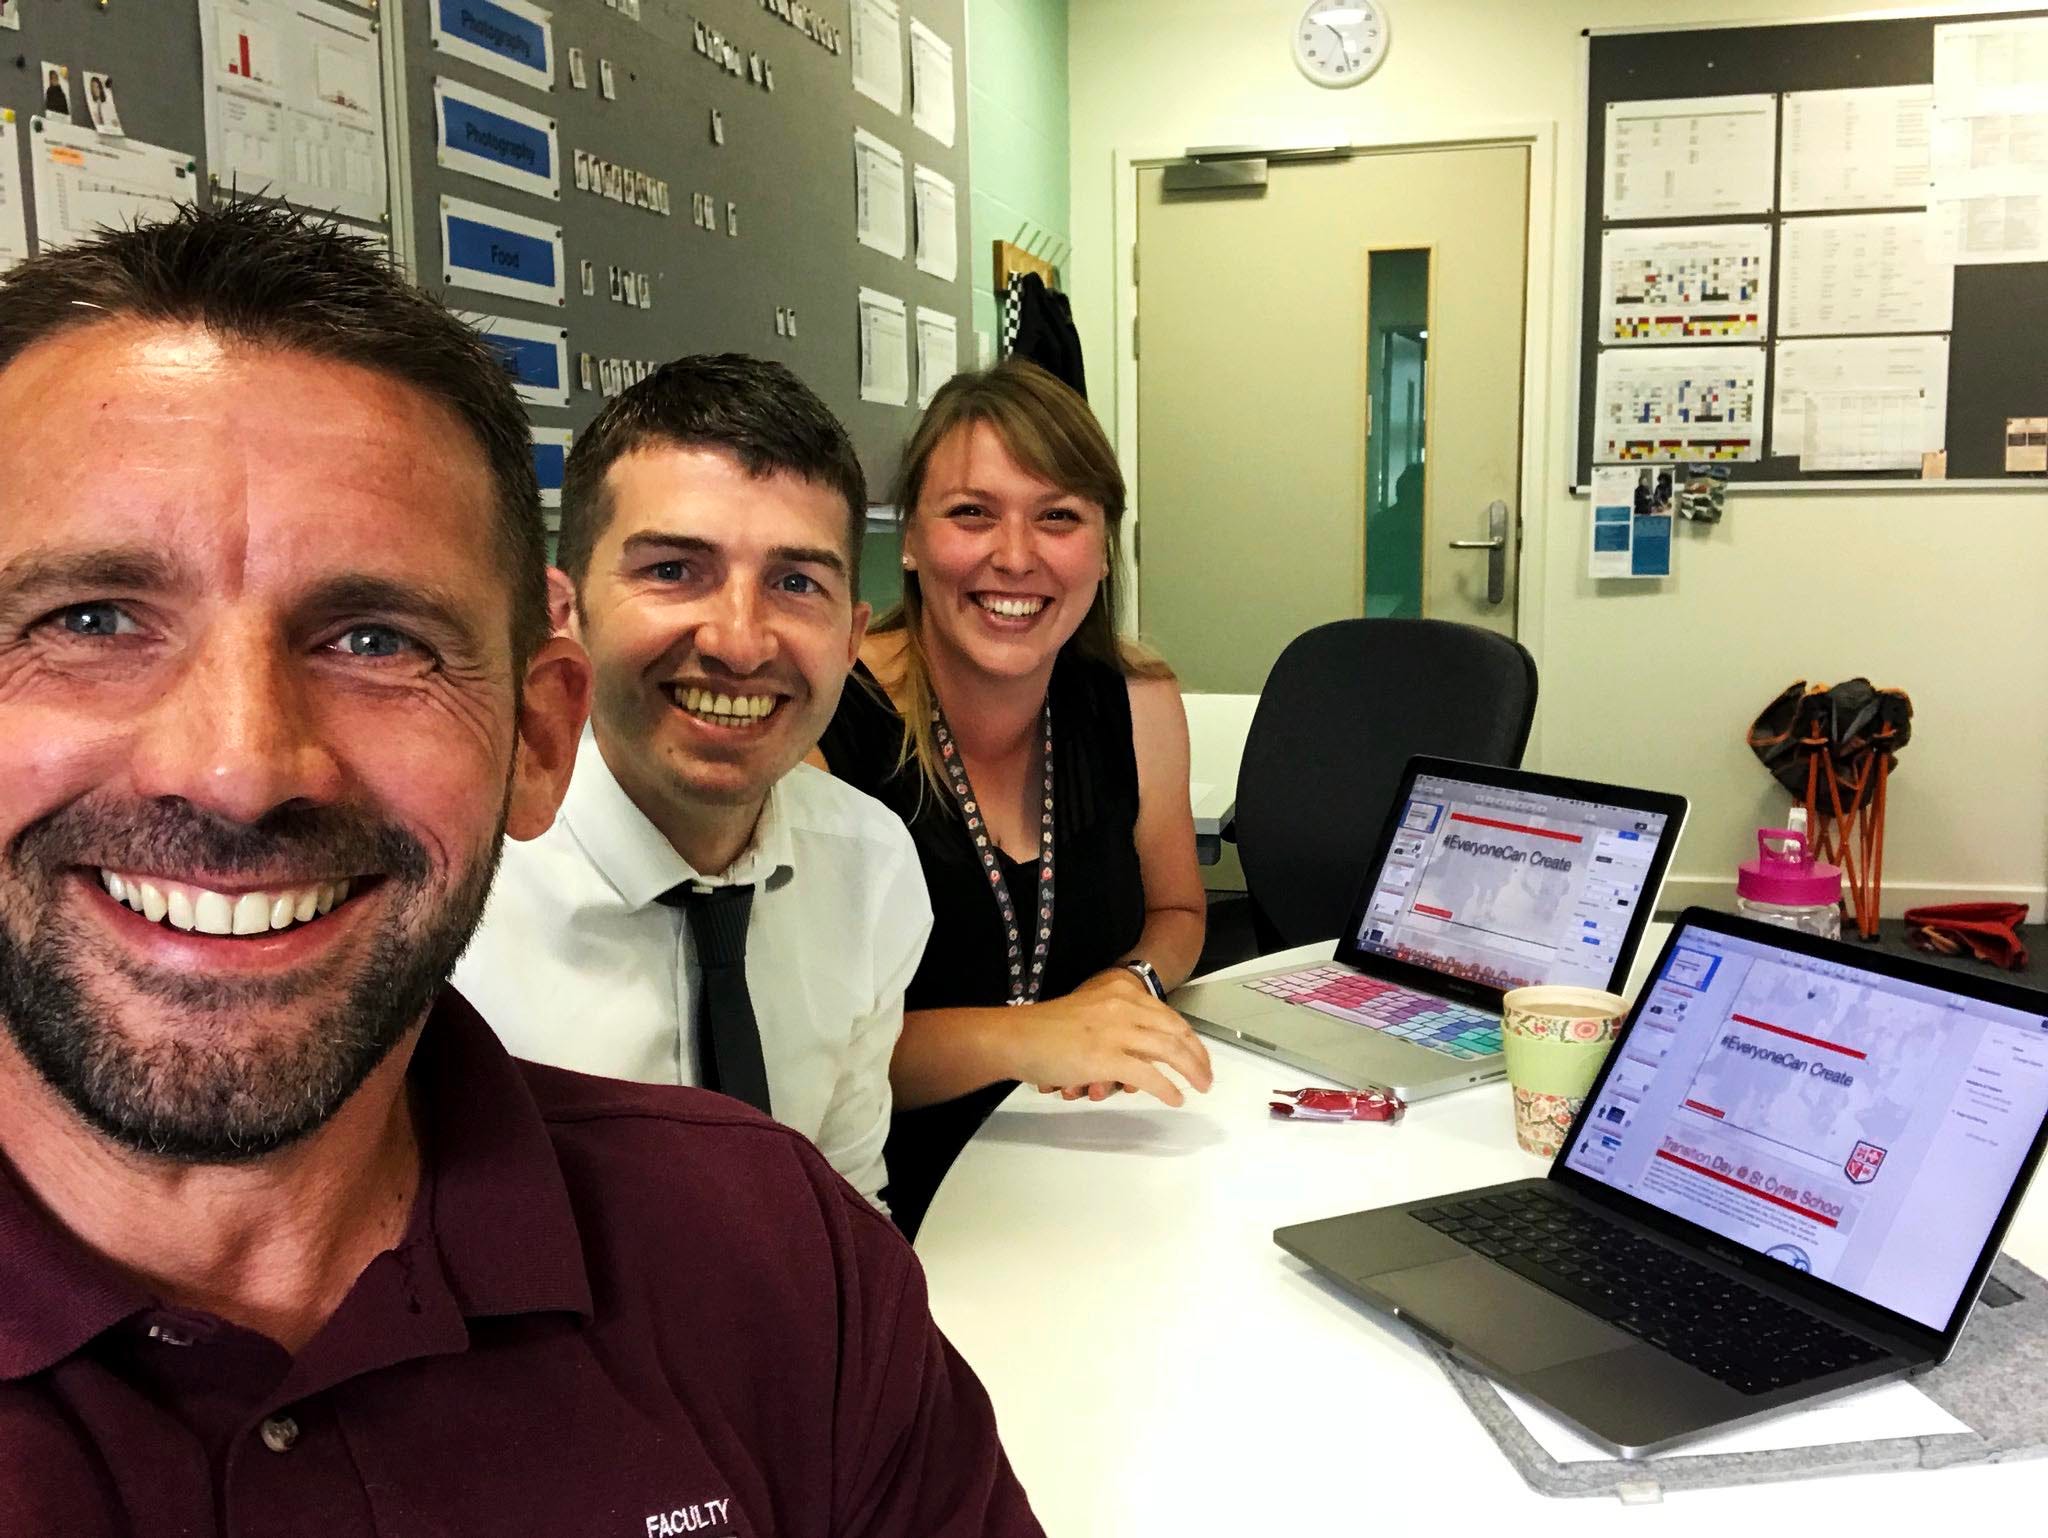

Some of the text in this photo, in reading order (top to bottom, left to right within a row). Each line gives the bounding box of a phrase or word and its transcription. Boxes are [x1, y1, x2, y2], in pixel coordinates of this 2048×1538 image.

[460, 8, 531, 58] Photography
[465, 121, 537, 166] Photography
[490, 244, 520, 269] Food
[1443, 834, 1573, 873] #EveryoneCan Create
[1720, 1034, 1855, 1087] #EveryoneCan Create
[1662, 1134, 1711, 1165] Transition
[1711, 1155, 1734, 1176] Day
[1749, 1170, 1764, 1185] St
[1800, 1190, 1845, 1217] School
[645, 1498, 730, 1538] FACULTY
